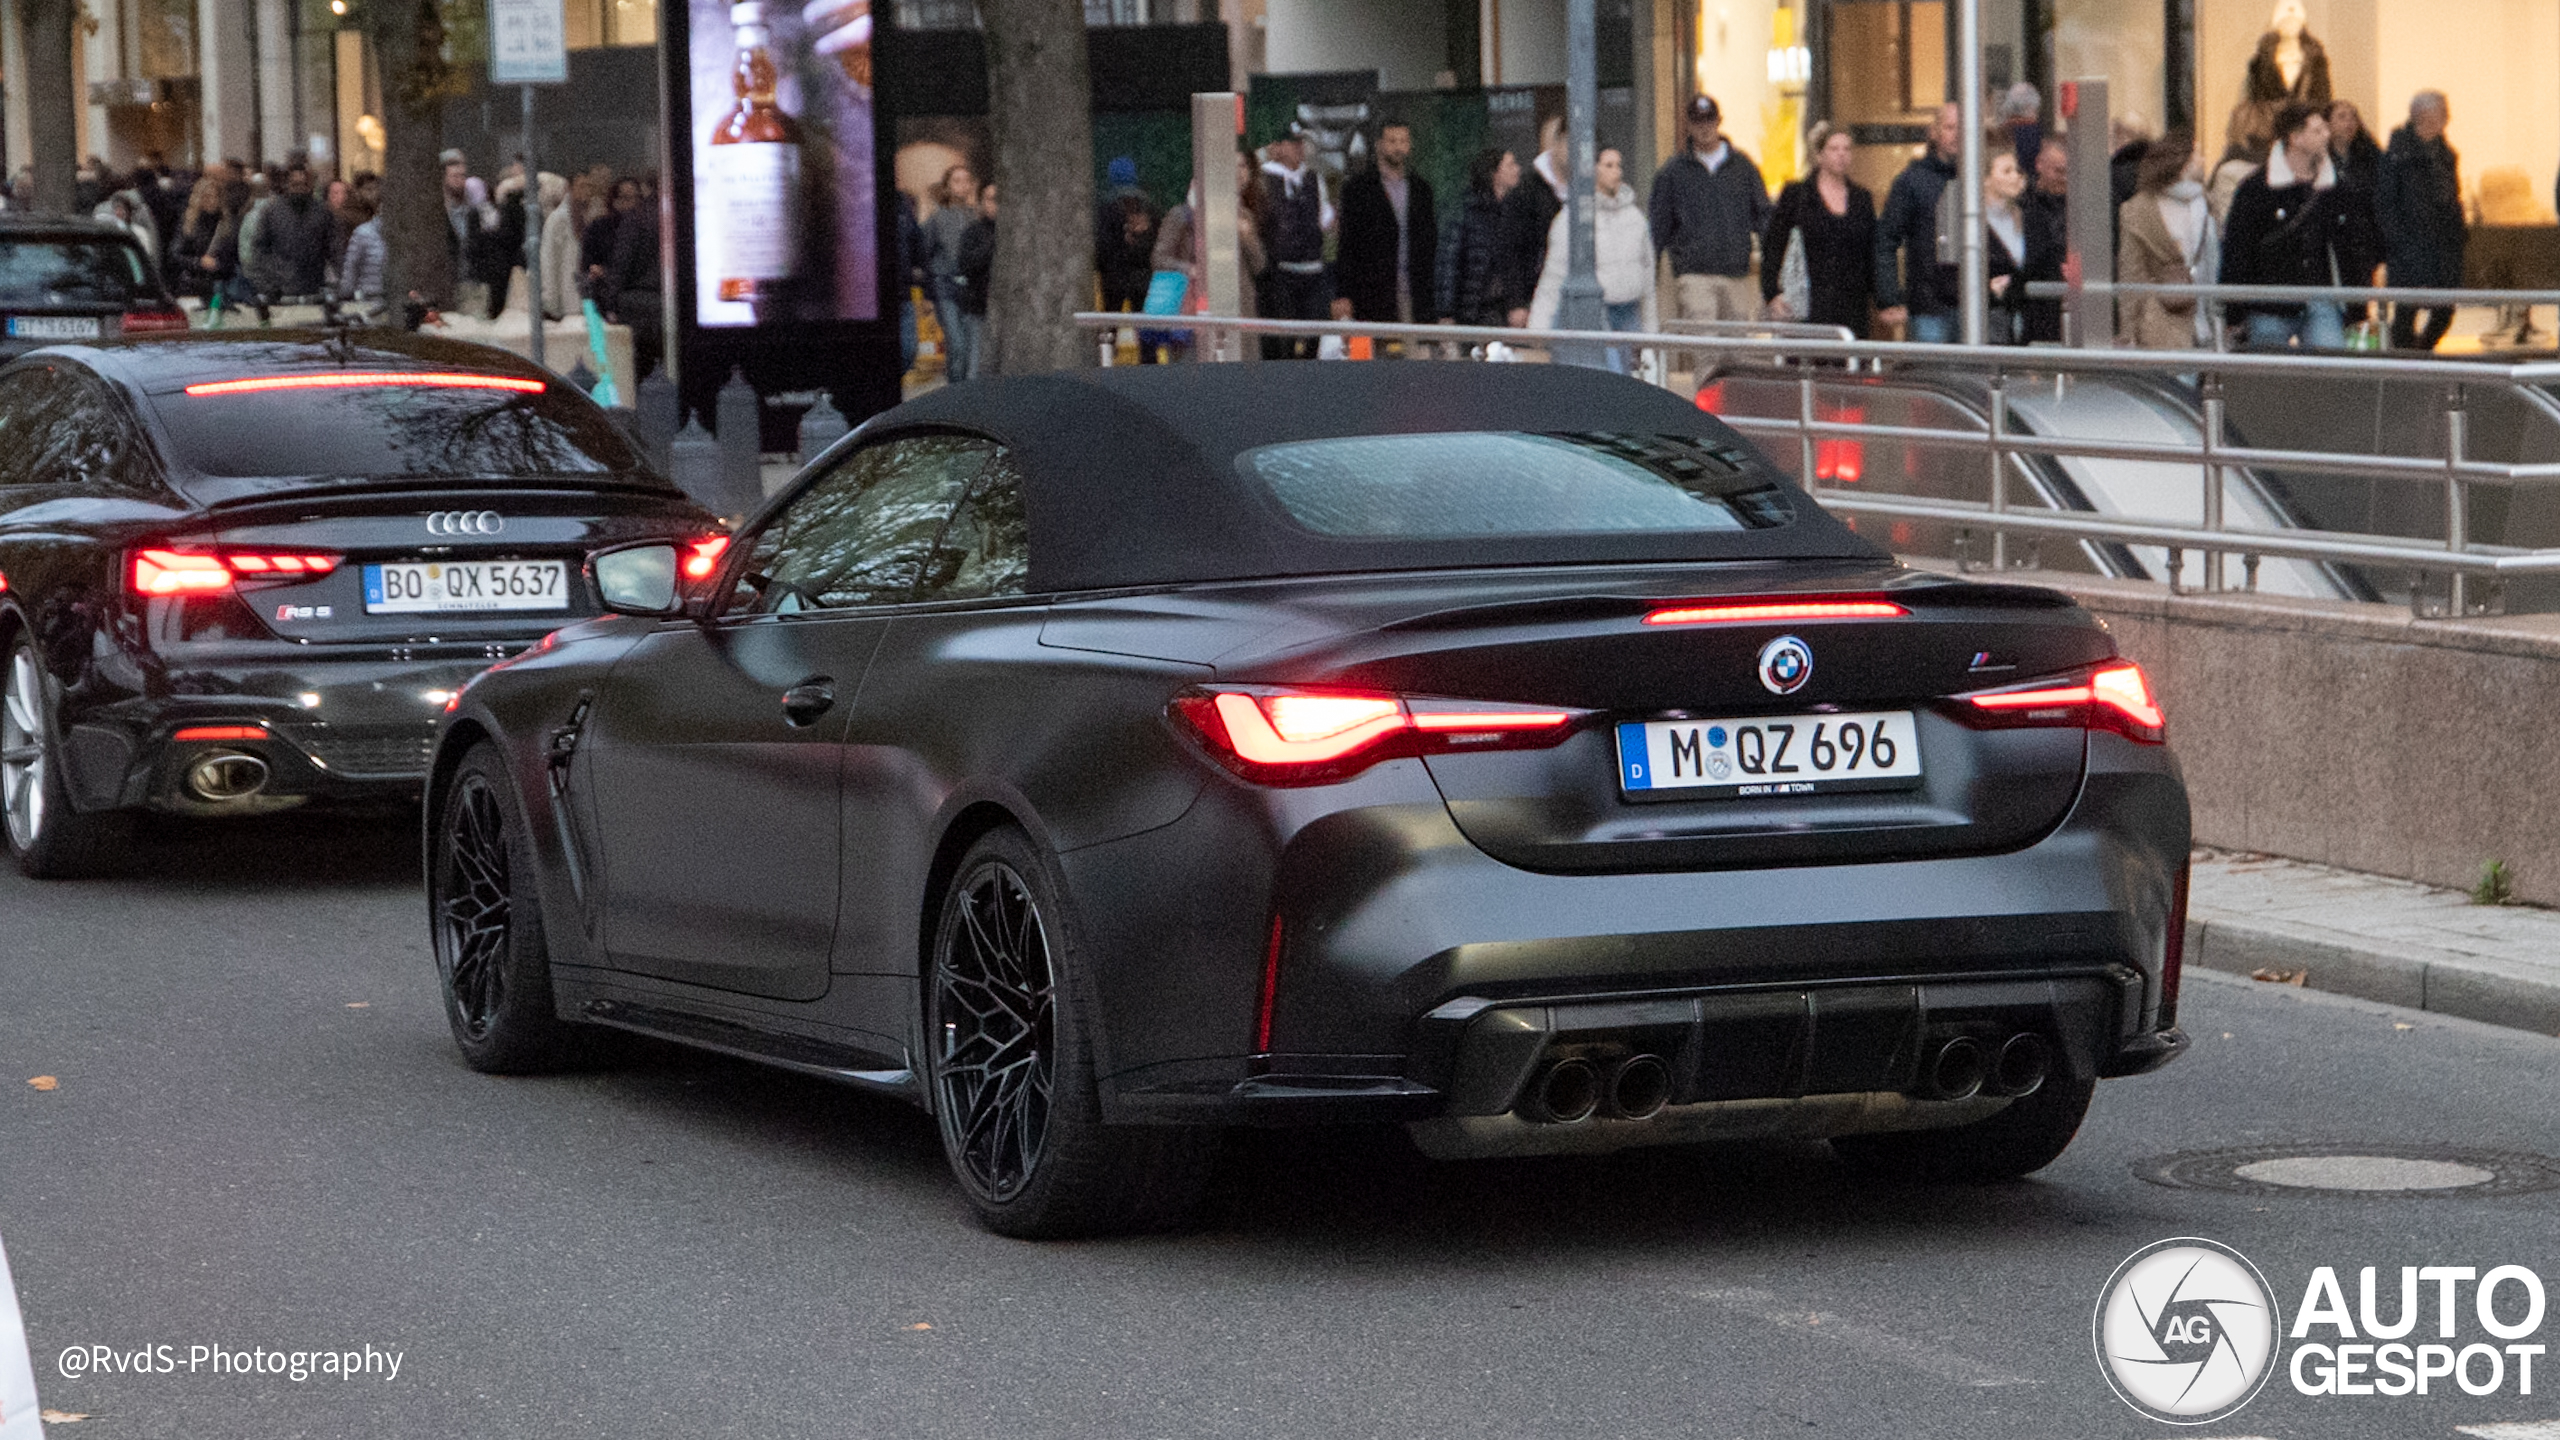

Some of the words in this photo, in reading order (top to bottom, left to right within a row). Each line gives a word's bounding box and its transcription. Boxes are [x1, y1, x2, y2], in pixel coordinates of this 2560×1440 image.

[386, 569, 422, 599] BO
[446, 566, 482, 598] QX
[490, 565, 560, 597] 5637
[277, 605, 314, 620] RS
[316, 606, 334, 619] 5
[1631, 764, 1643, 780] D
[1670, 729, 1703, 777] M
[1736, 724, 1800, 775] QZ
[1811, 720, 1897, 771] 696
[1738, 785, 1763, 796] BORN
[1763, 785, 1773, 794] IN
[1791, 783, 1815, 793] TOWN
